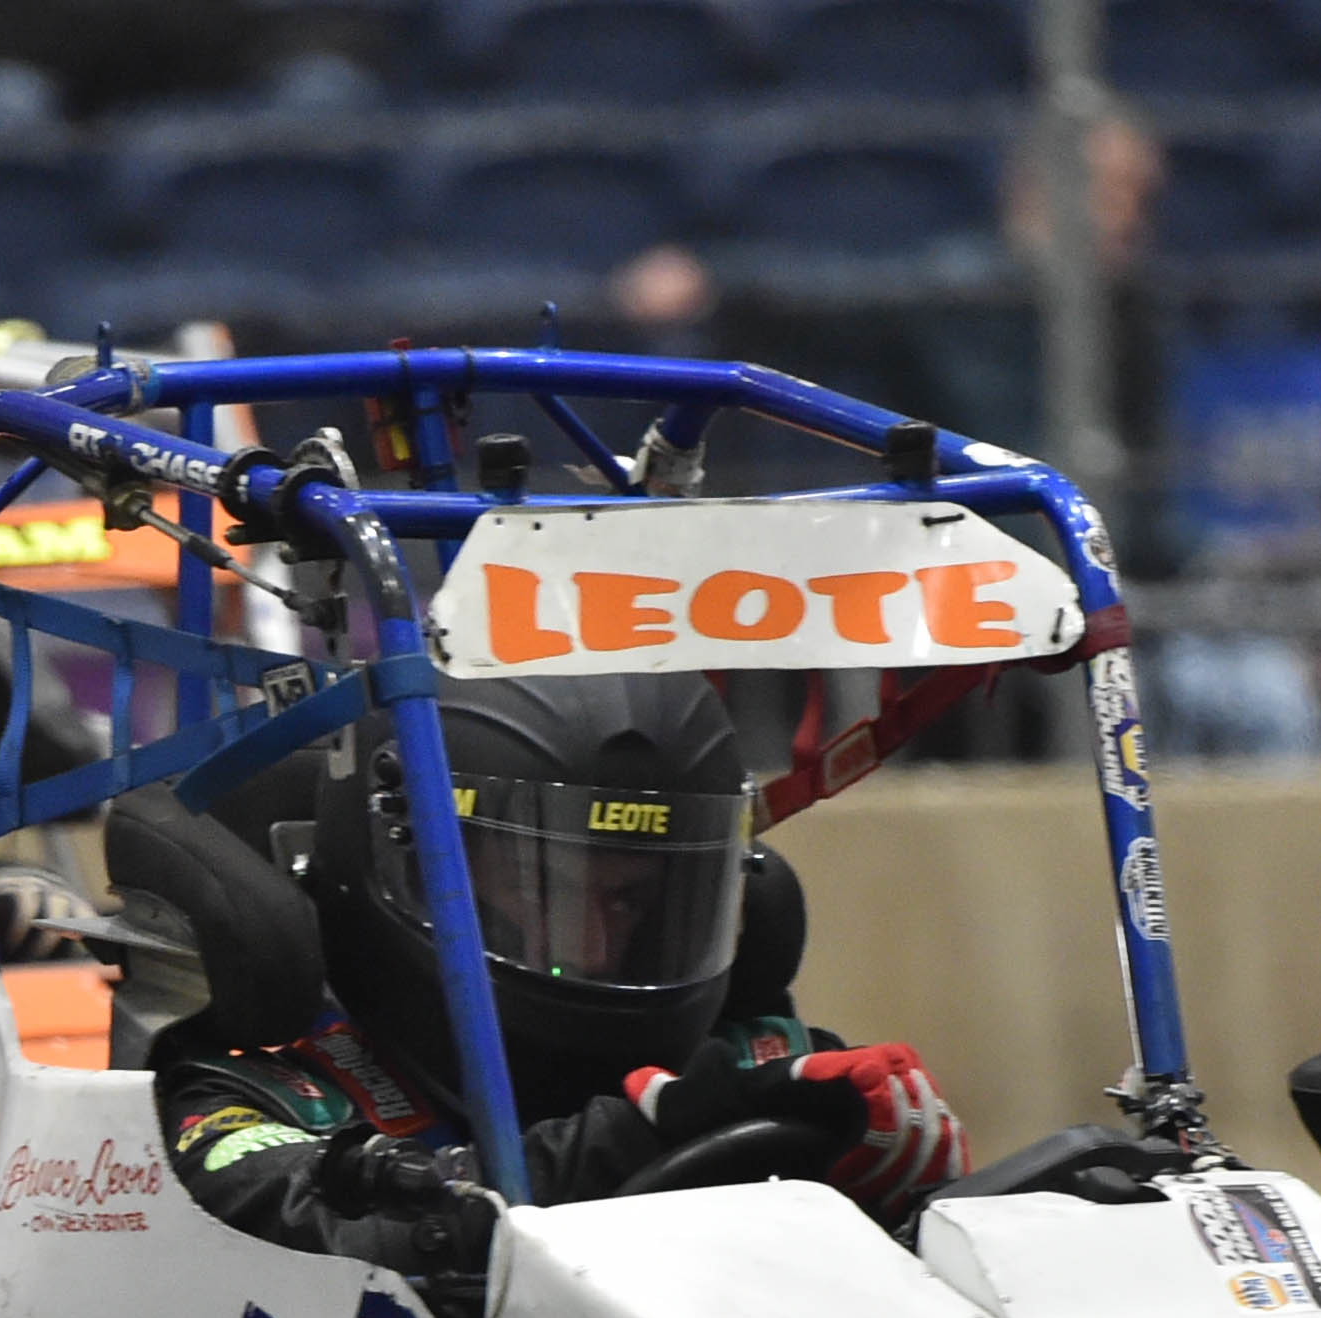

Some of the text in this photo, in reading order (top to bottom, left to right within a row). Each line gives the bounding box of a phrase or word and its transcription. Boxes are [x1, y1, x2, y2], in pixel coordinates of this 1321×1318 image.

[131, 442, 250, 503] CHASSS
[482, 560, 1023, 665] LEOTE
[587, 801, 672, 834] LEOTE
